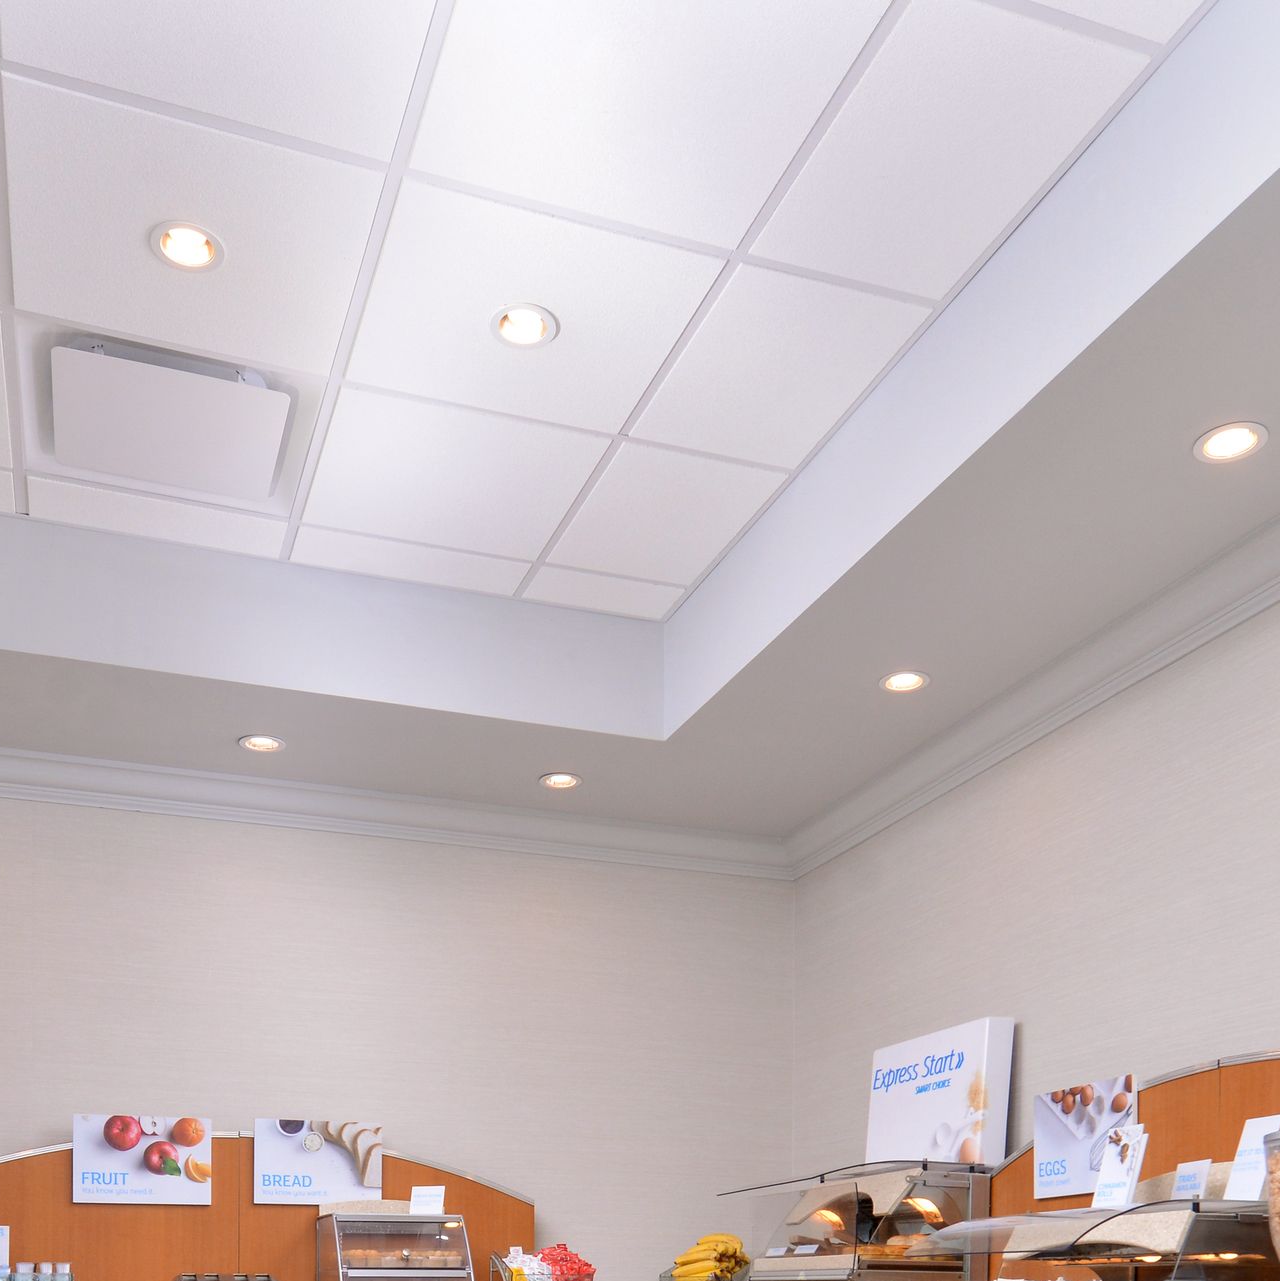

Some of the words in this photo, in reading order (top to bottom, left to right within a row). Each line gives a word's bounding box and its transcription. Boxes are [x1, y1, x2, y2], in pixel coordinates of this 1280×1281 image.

[873, 1063, 919, 1093] Express
[922, 1049, 955, 1078] Start
[1038, 1159, 1067, 1177] EGGS
[81, 1171, 129, 1186] FRUIT
[261, 1174, 312, 1188] BREAD
